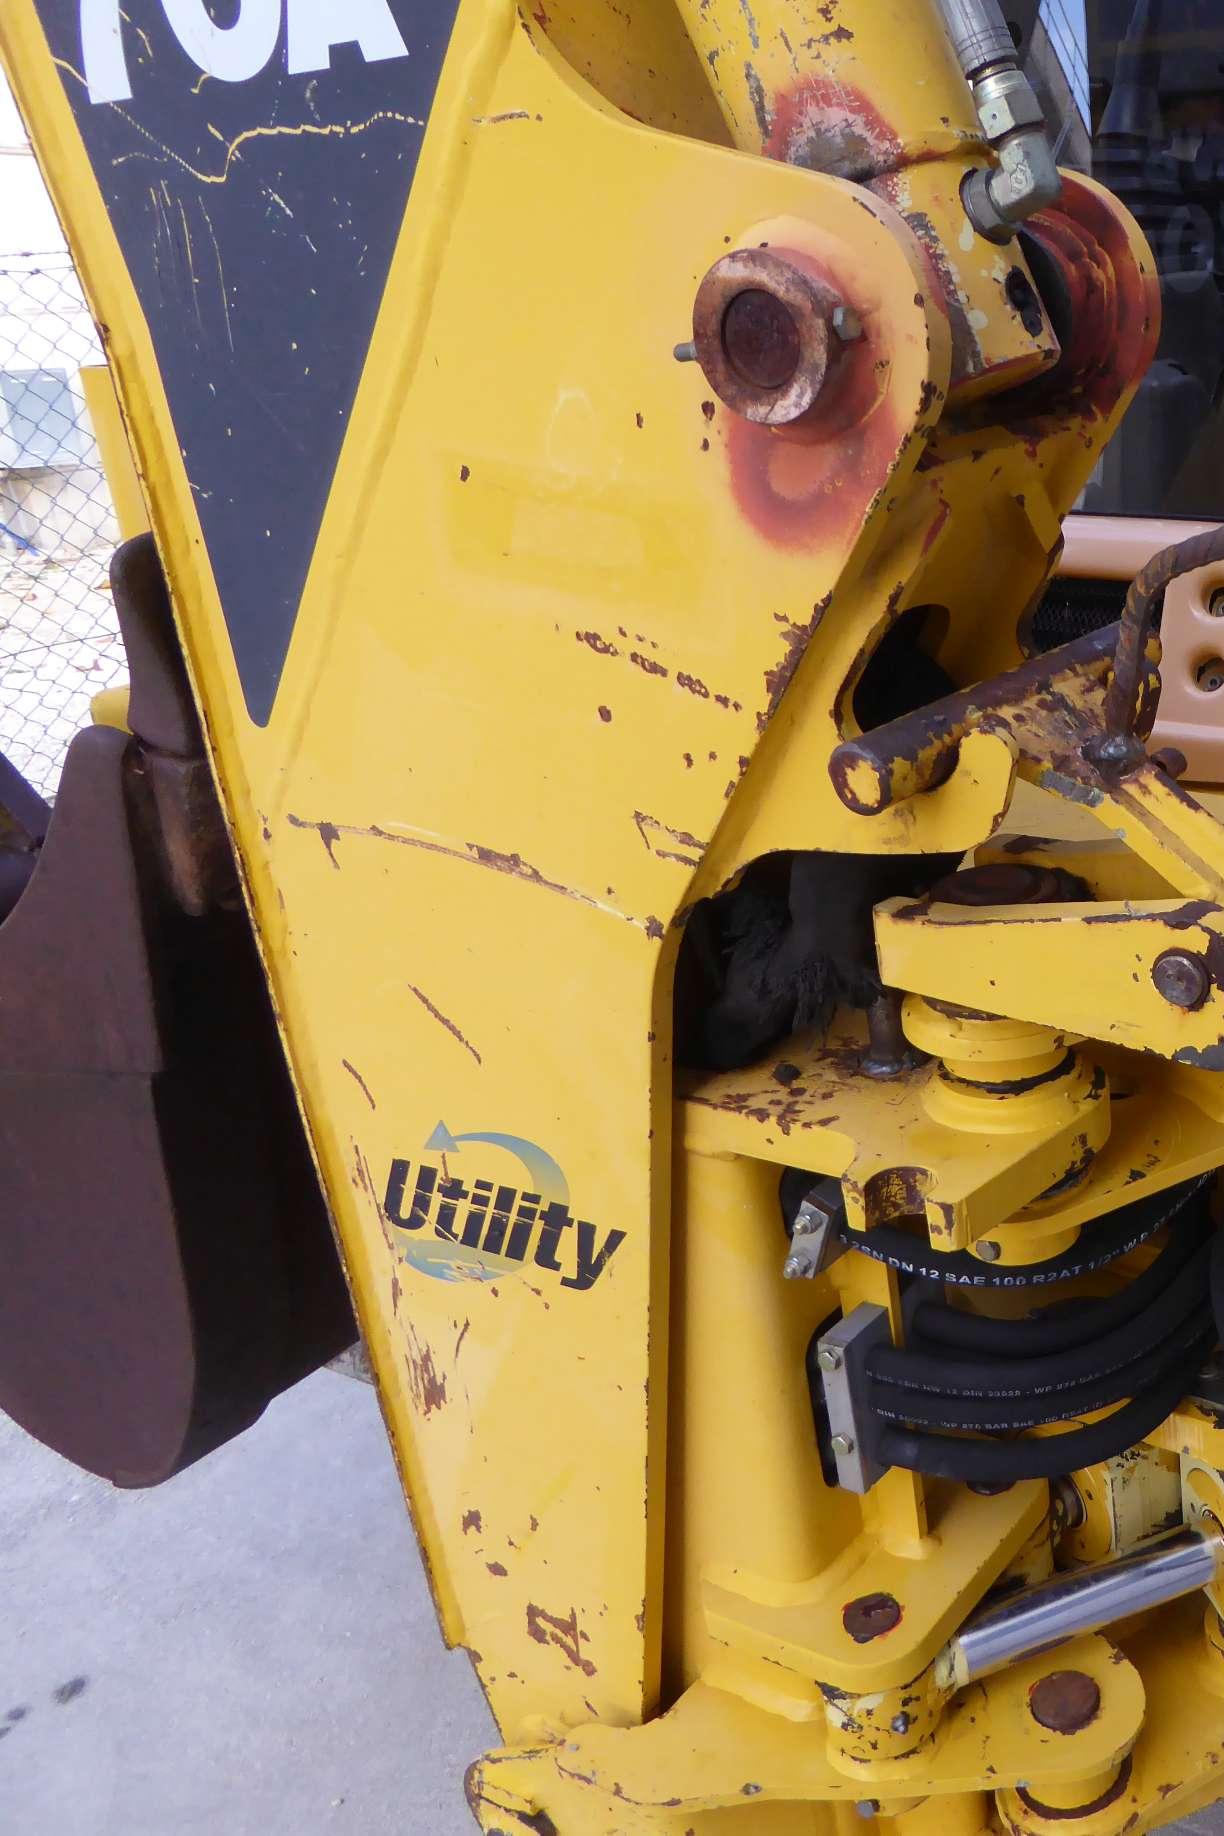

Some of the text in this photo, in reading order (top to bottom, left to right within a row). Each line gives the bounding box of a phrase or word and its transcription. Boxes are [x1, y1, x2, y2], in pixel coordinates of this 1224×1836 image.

[384, 1158, 627, 1290] Utility
[888, 1256, 914, 1273] DN
[919, 1267, 941, 1280] 12
[945, 1272, 987, 1286] SAE
[991, 1275, 1027, 1287] 100
[1032, 1264, 1087, 1285] R2AT
